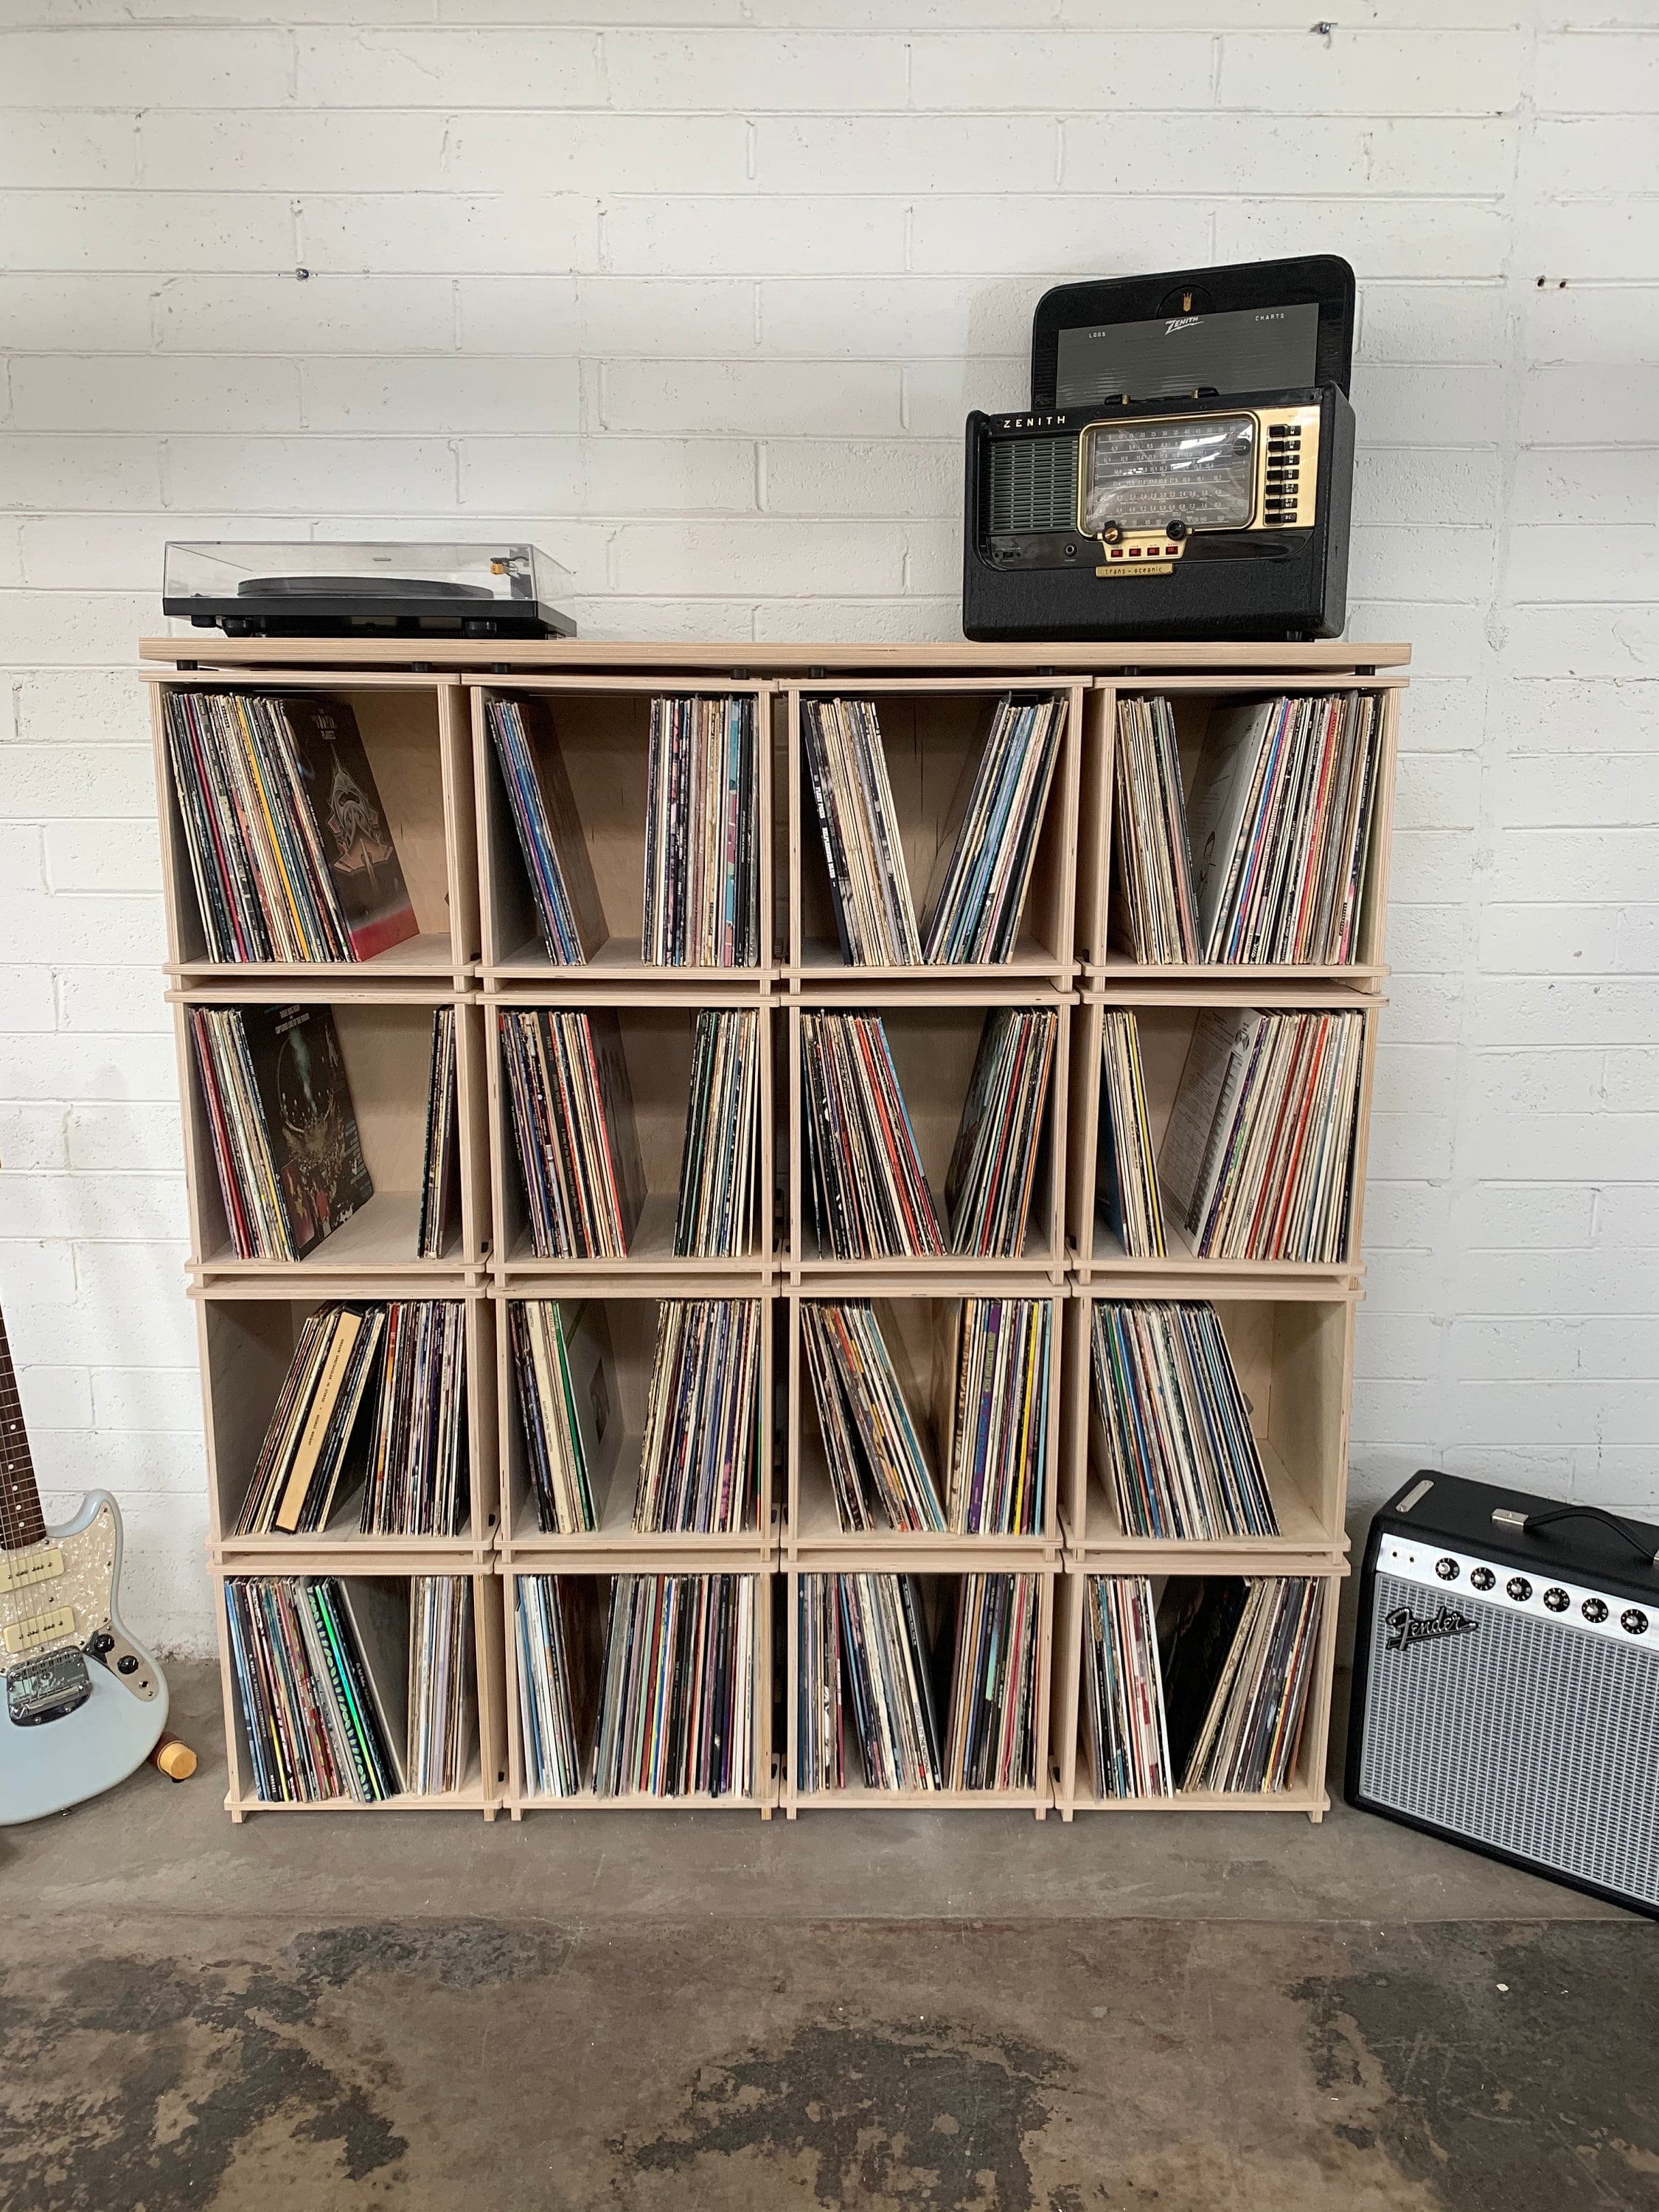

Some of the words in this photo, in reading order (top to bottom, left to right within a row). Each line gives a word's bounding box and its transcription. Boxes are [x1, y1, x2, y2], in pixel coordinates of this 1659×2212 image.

[1164, 316, 1204, 335] ZENITH
[1255, 313, 1284, 321] CHARTS
[1003, 414, 1067, 428] ZENITH
[1387, 1606, 1478, 1651] Fender
[254, 1683, 262, 1709] WASTELAND
[259, 1711, 267, 1737] COMPANION
[922, 1747, 931, 1774] NATIONAL
